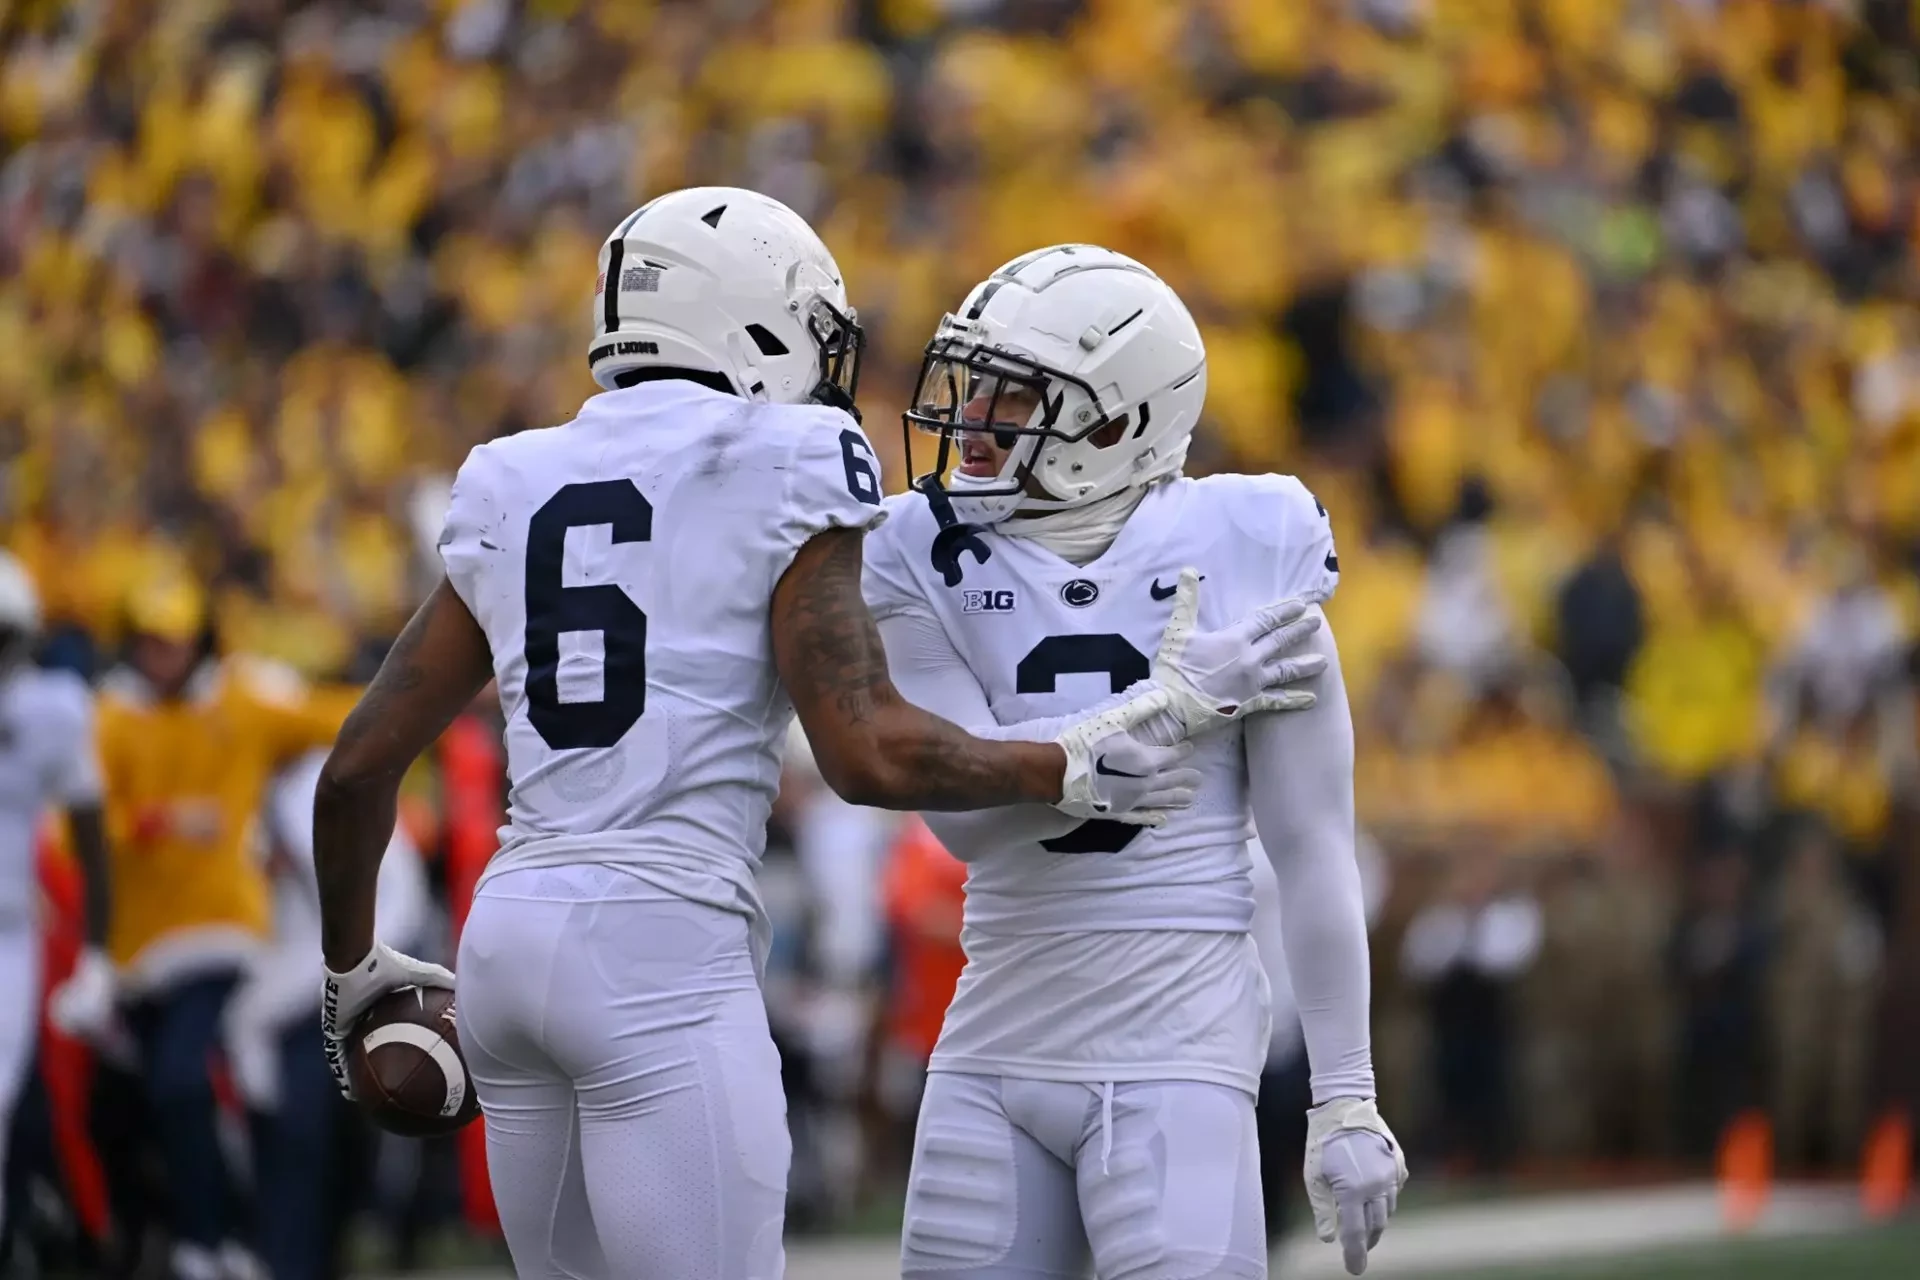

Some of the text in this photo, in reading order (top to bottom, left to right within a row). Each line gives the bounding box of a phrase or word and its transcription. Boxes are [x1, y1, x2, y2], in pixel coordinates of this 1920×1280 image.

[839, 428, 881, 506] 6
[525, 478, 653, 750] 6
[324, 977, 339, 1034] STATE
